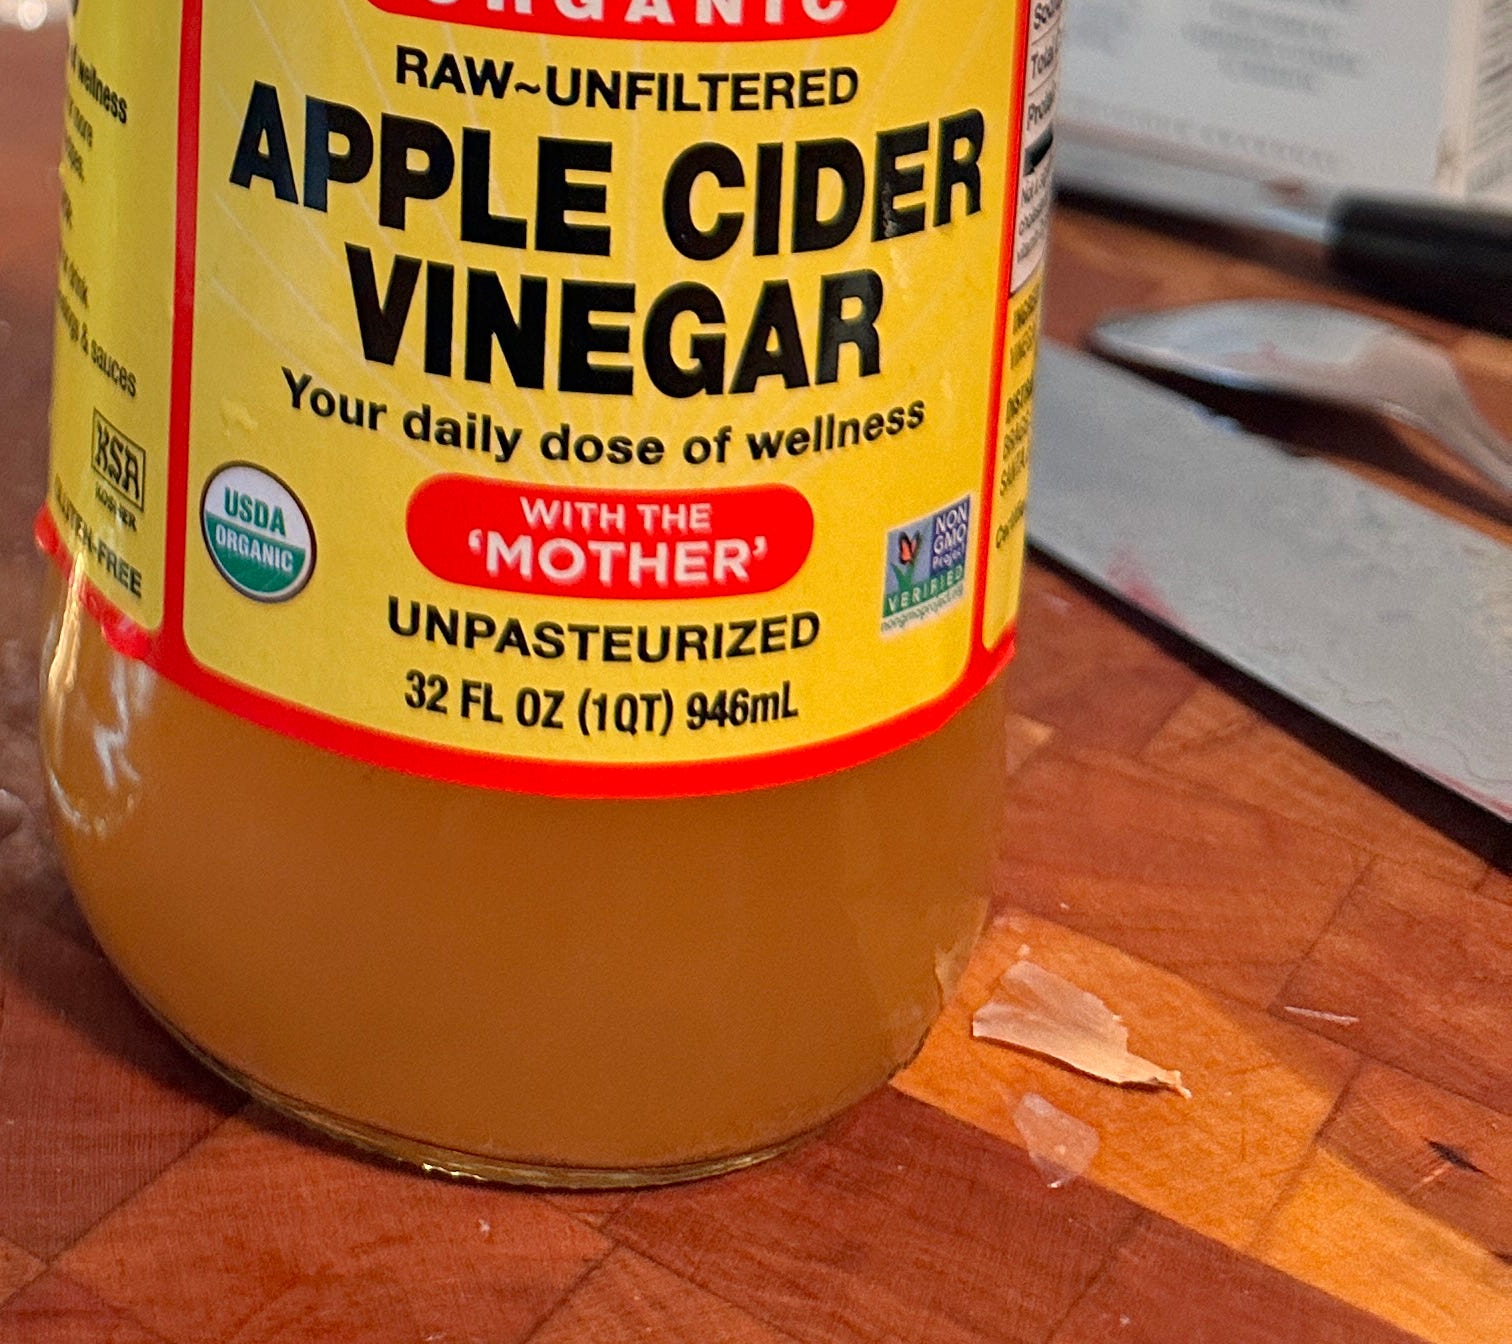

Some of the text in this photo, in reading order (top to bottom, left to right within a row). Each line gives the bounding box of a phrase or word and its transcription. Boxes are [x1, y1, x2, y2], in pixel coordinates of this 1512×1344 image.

[78, 56, 127, 125] wellness
[228, 79, 614, 257] APPLE
[662, 108, 987, 261] CIDER
[344, 242, 885, 399] VINEGAR
[91, 338, 137, 398] sauces
[282, 366, 926, 466] Your daily dose of wellness
[224, 487, 286, 536] USDA
[520, 495, 713, 534] WITH THE
[934, 523, 967, 555] GMO
[936, 503, 968, 535] NON
[215, 523, 294, 573] ORGANIC
[888, 564, 963, 612] VERIFIED
[387, 595, 821, 664] UNPASTEURIZED
[404, 669, 800, 737] 32 FL OZ (1QT) 946mL
